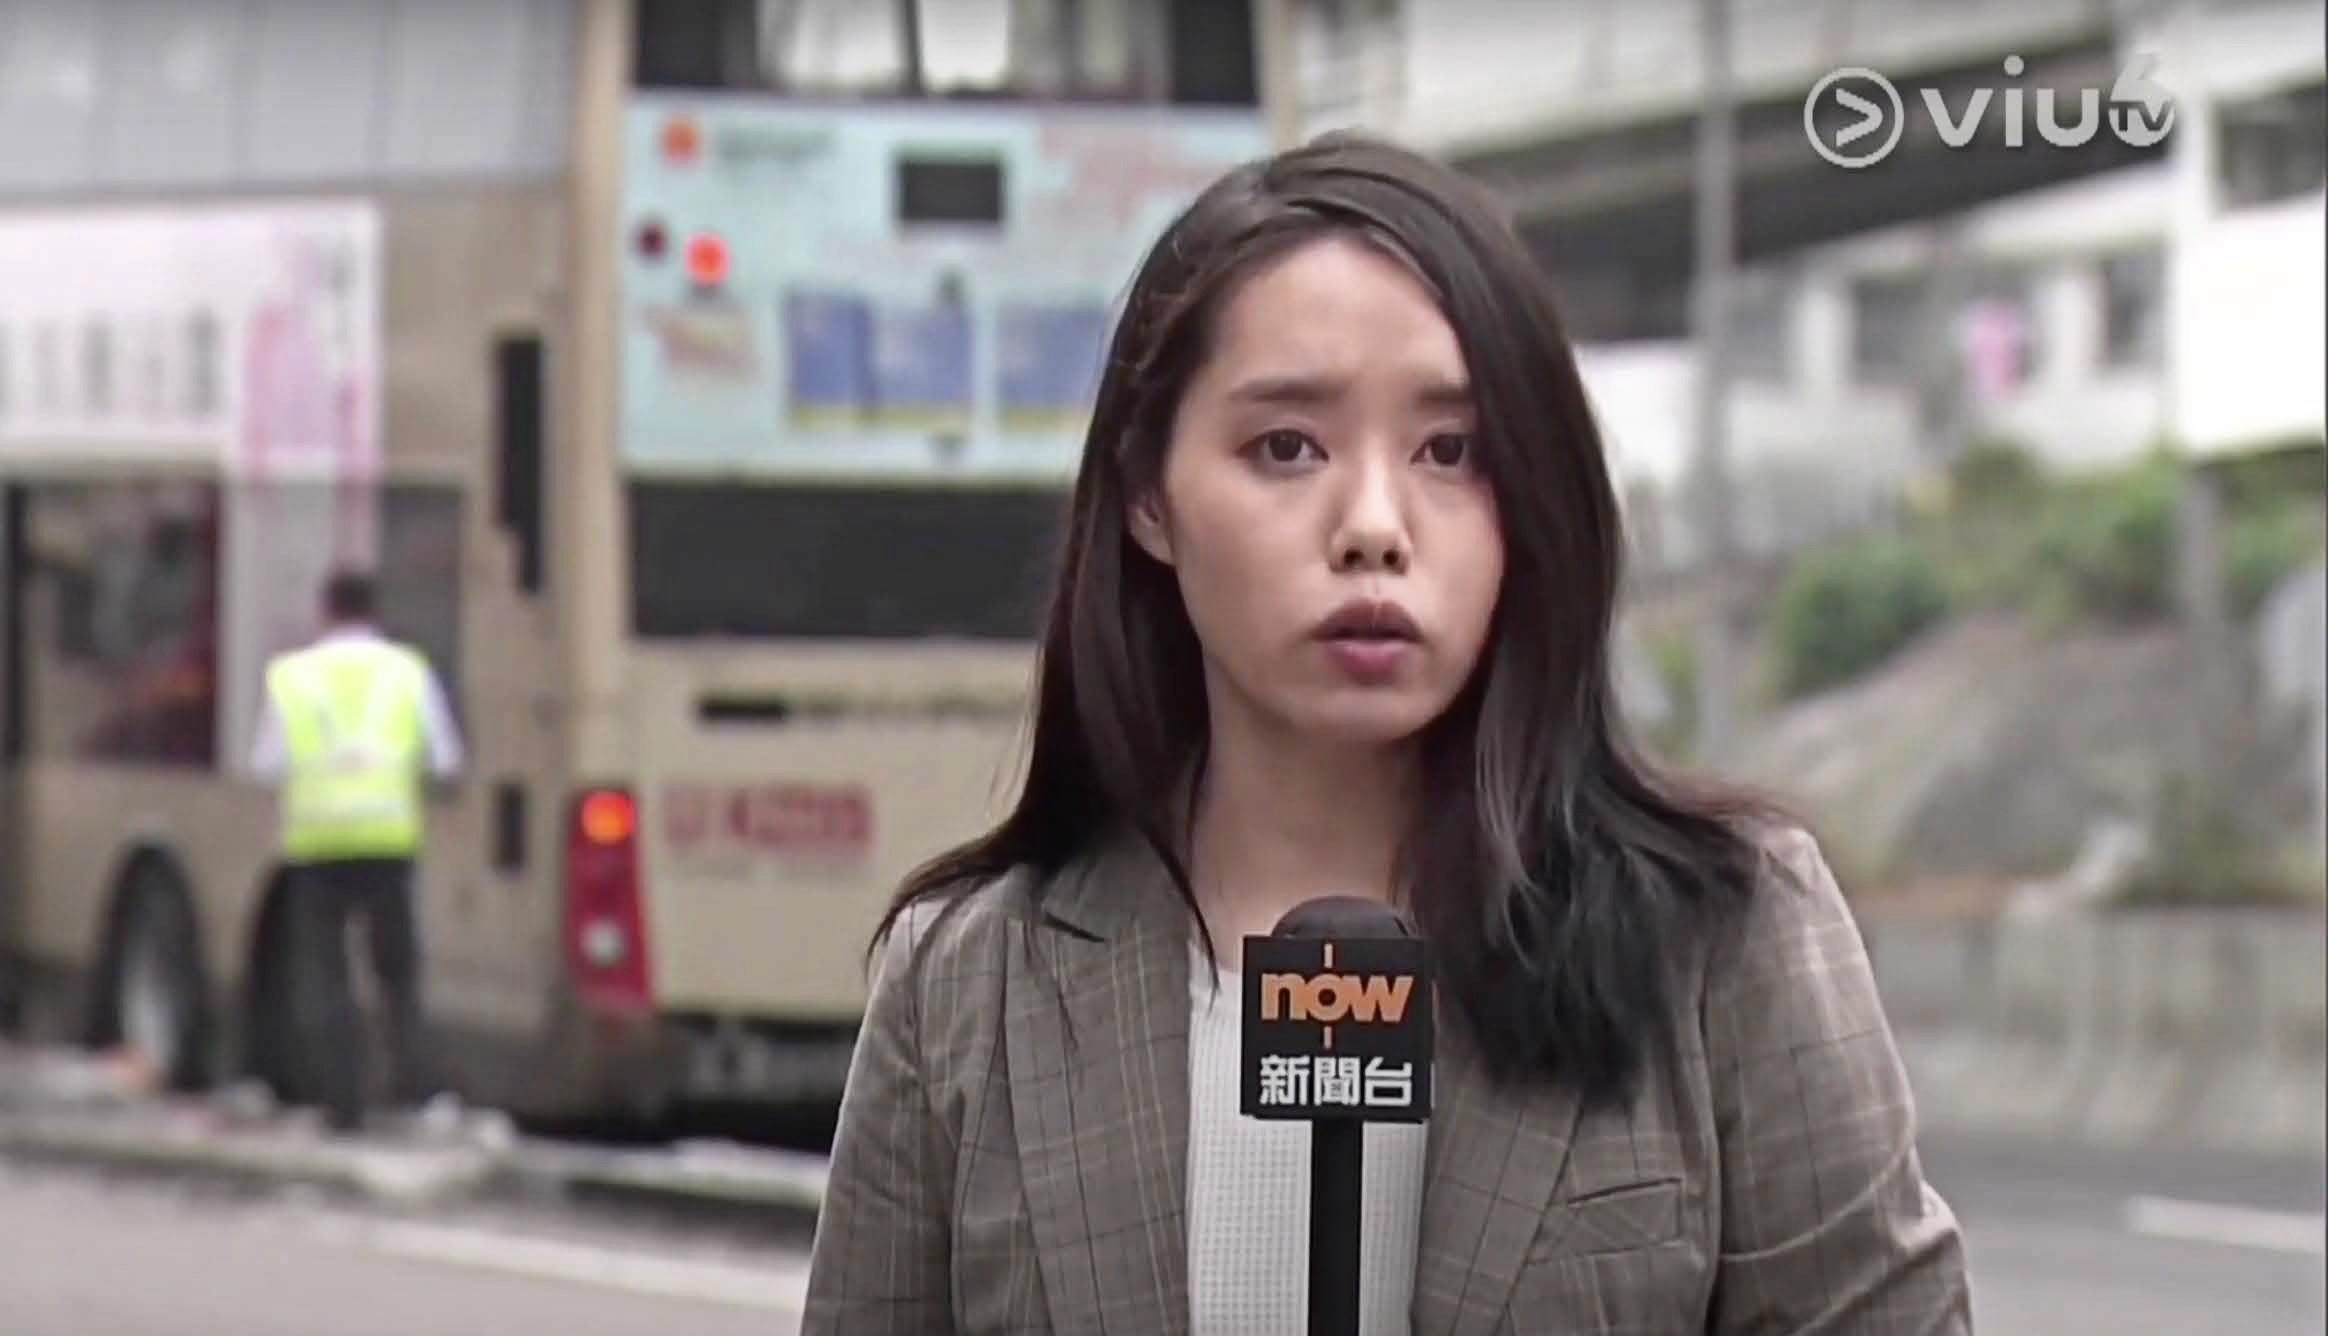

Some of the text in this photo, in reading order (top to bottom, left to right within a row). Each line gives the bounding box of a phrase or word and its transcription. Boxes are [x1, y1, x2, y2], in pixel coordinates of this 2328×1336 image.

[1261, 972, 1414, 1022] now
[1259, 1054, 1413, 1107] 新聞台
